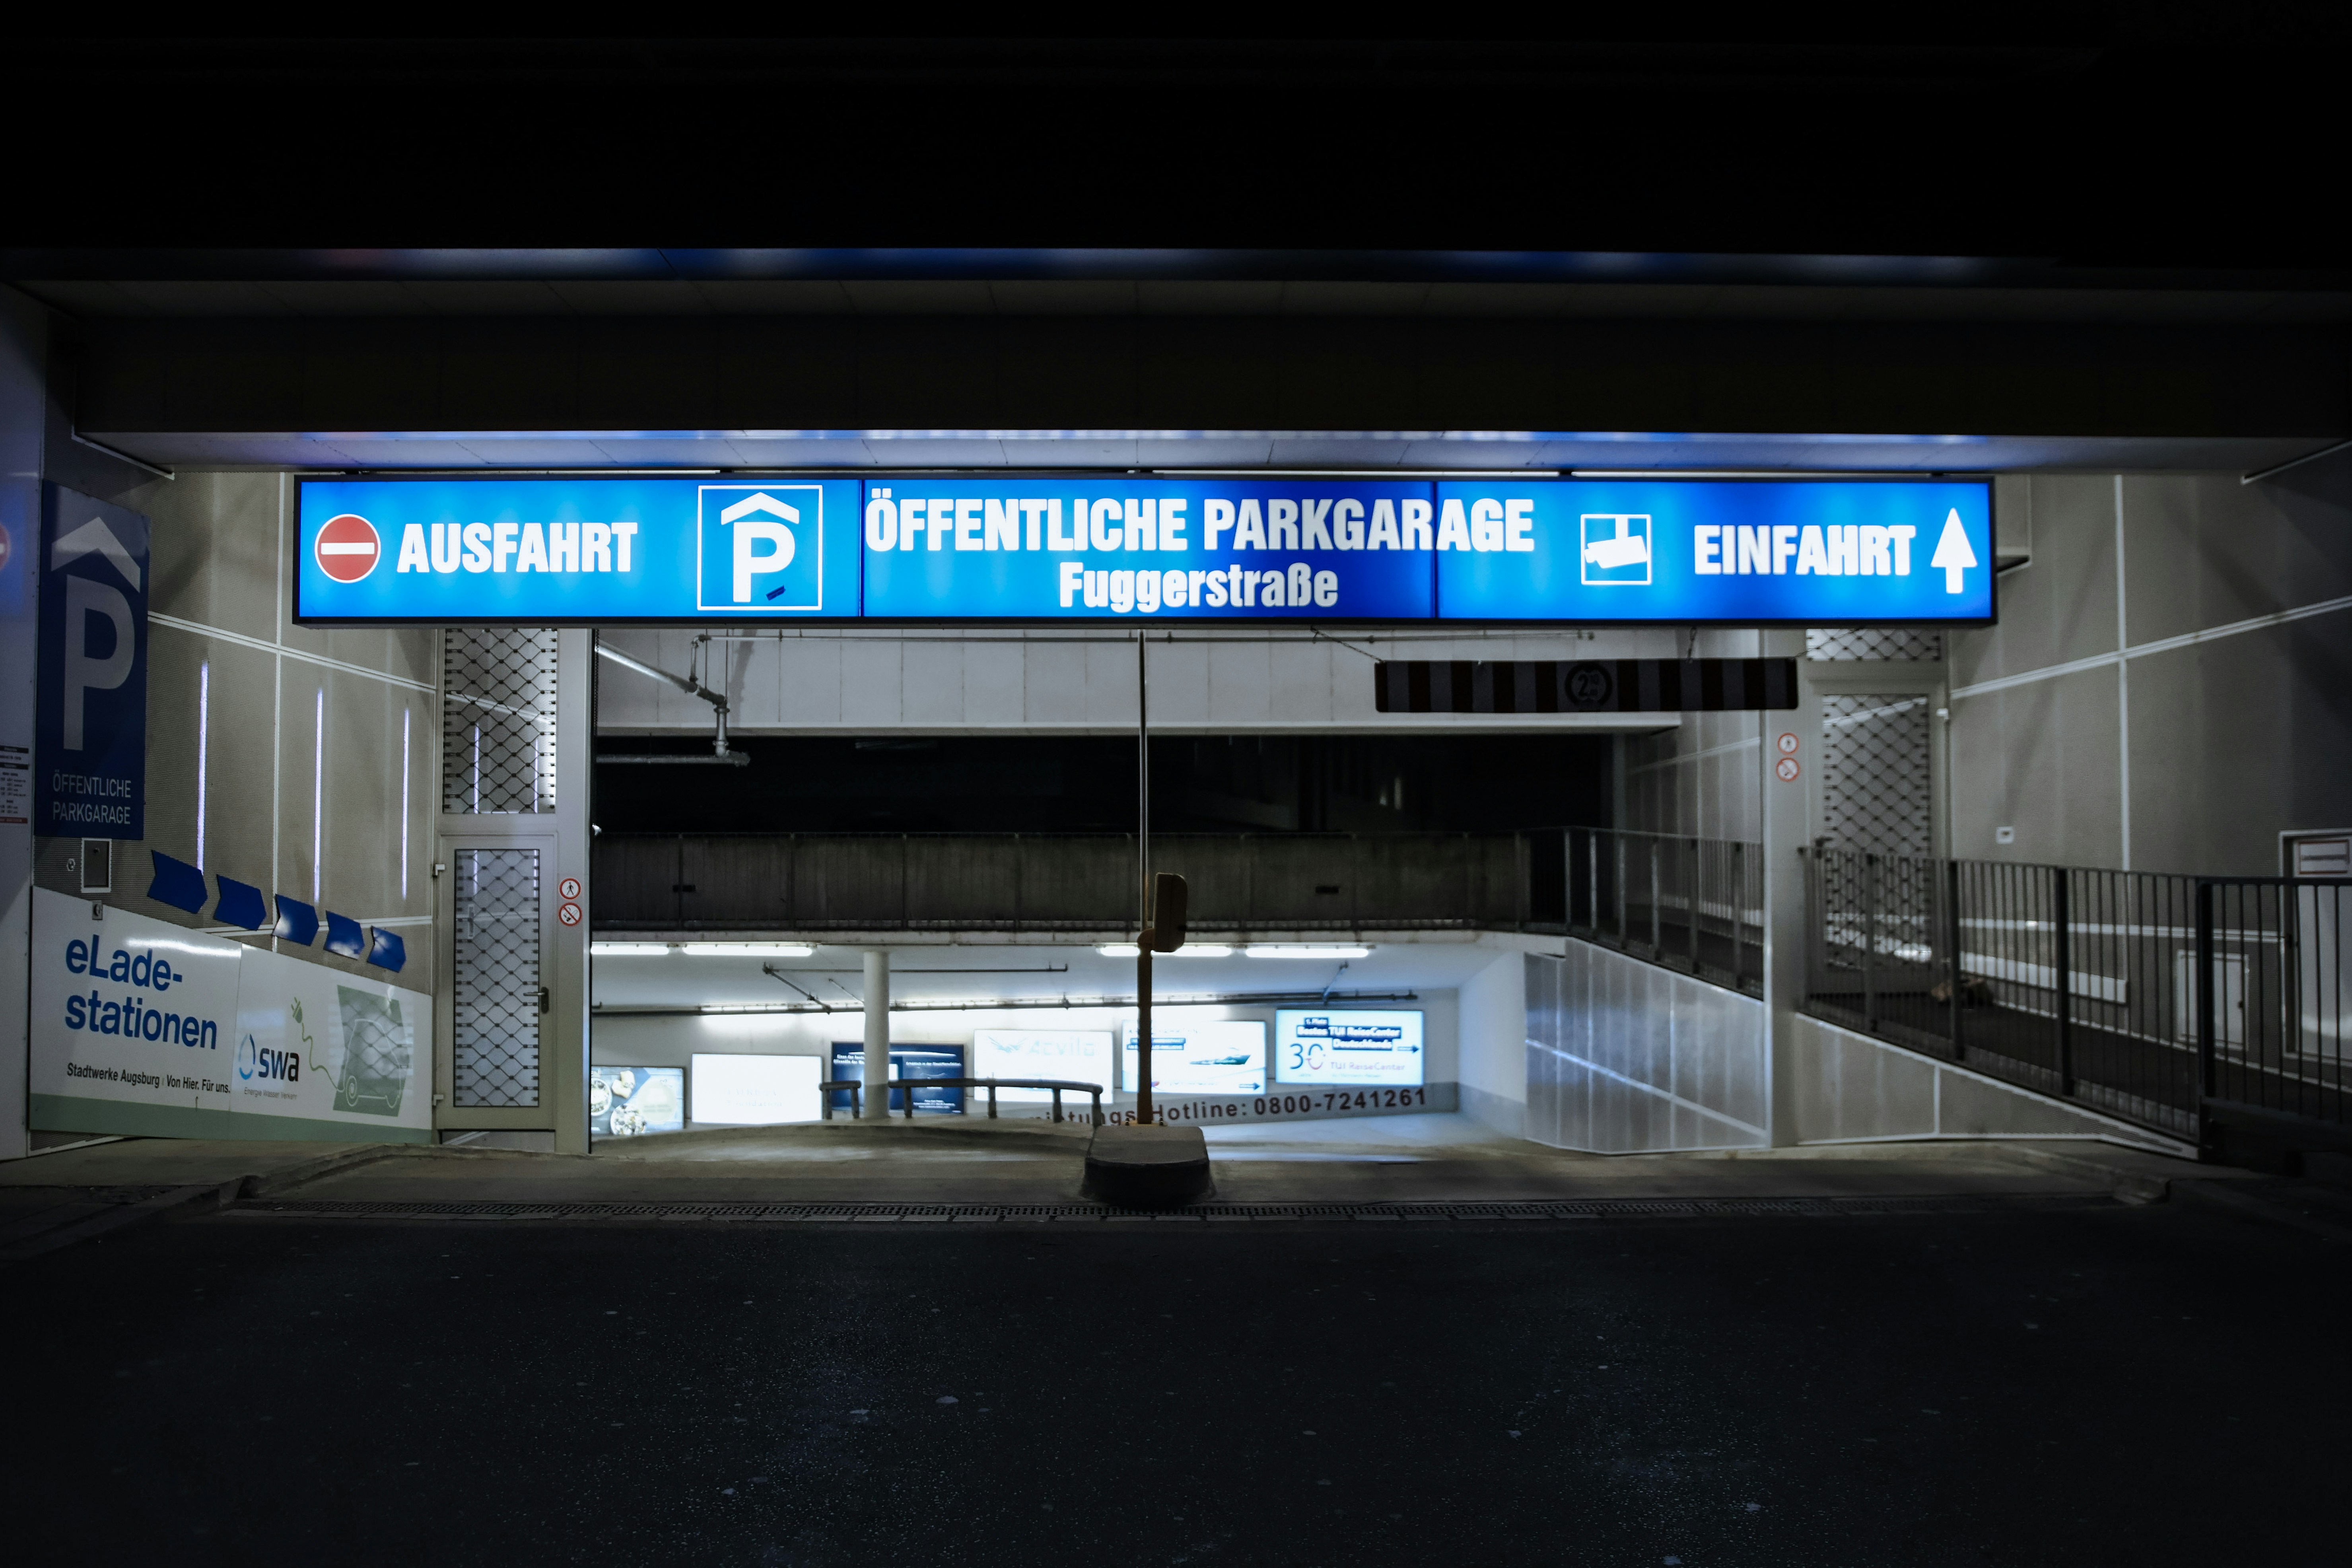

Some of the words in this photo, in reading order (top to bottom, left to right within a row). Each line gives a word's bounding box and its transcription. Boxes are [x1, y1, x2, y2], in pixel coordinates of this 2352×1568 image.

[865, 488, 1188, 552] ÖFFENTLICHE
[1204, 498, 1534, 552] PARKGARAGE
[397, 522, 638, 573] AUSFAHRT
[733, 522, 795, 602] P
[1695, 525, 1916, 575] EINFAHRT
[1060, 562, 1339, 613] Fuggerstraße
[64, 574, 135, 751] P
[52, 769, 131, 799] ÖFFENTLICHE
[52, 803, 131, 825] PARKGARAGE
[66, 935, 183, 991] eLade-
[65, 989, 218, 1050] stationen
[1329, 1026, 1346, 1036] TUI
[67, 1062, 118, 1081] Stadtwerke
[120, 1069, 160, 1088] Augsburg
[167, 1074, 181, 1088] Von
[183, 1076, 199, 1090] Hier.
[202, 1079, 214, 1092] Für
[216, 1083, 231, 1094] uns.
[259, 1047, 299, 1082] swa
[1153, 1101, 1247, 1122] Hotline:
[1254, 1088, 1427, 1116] 0800-7241261
